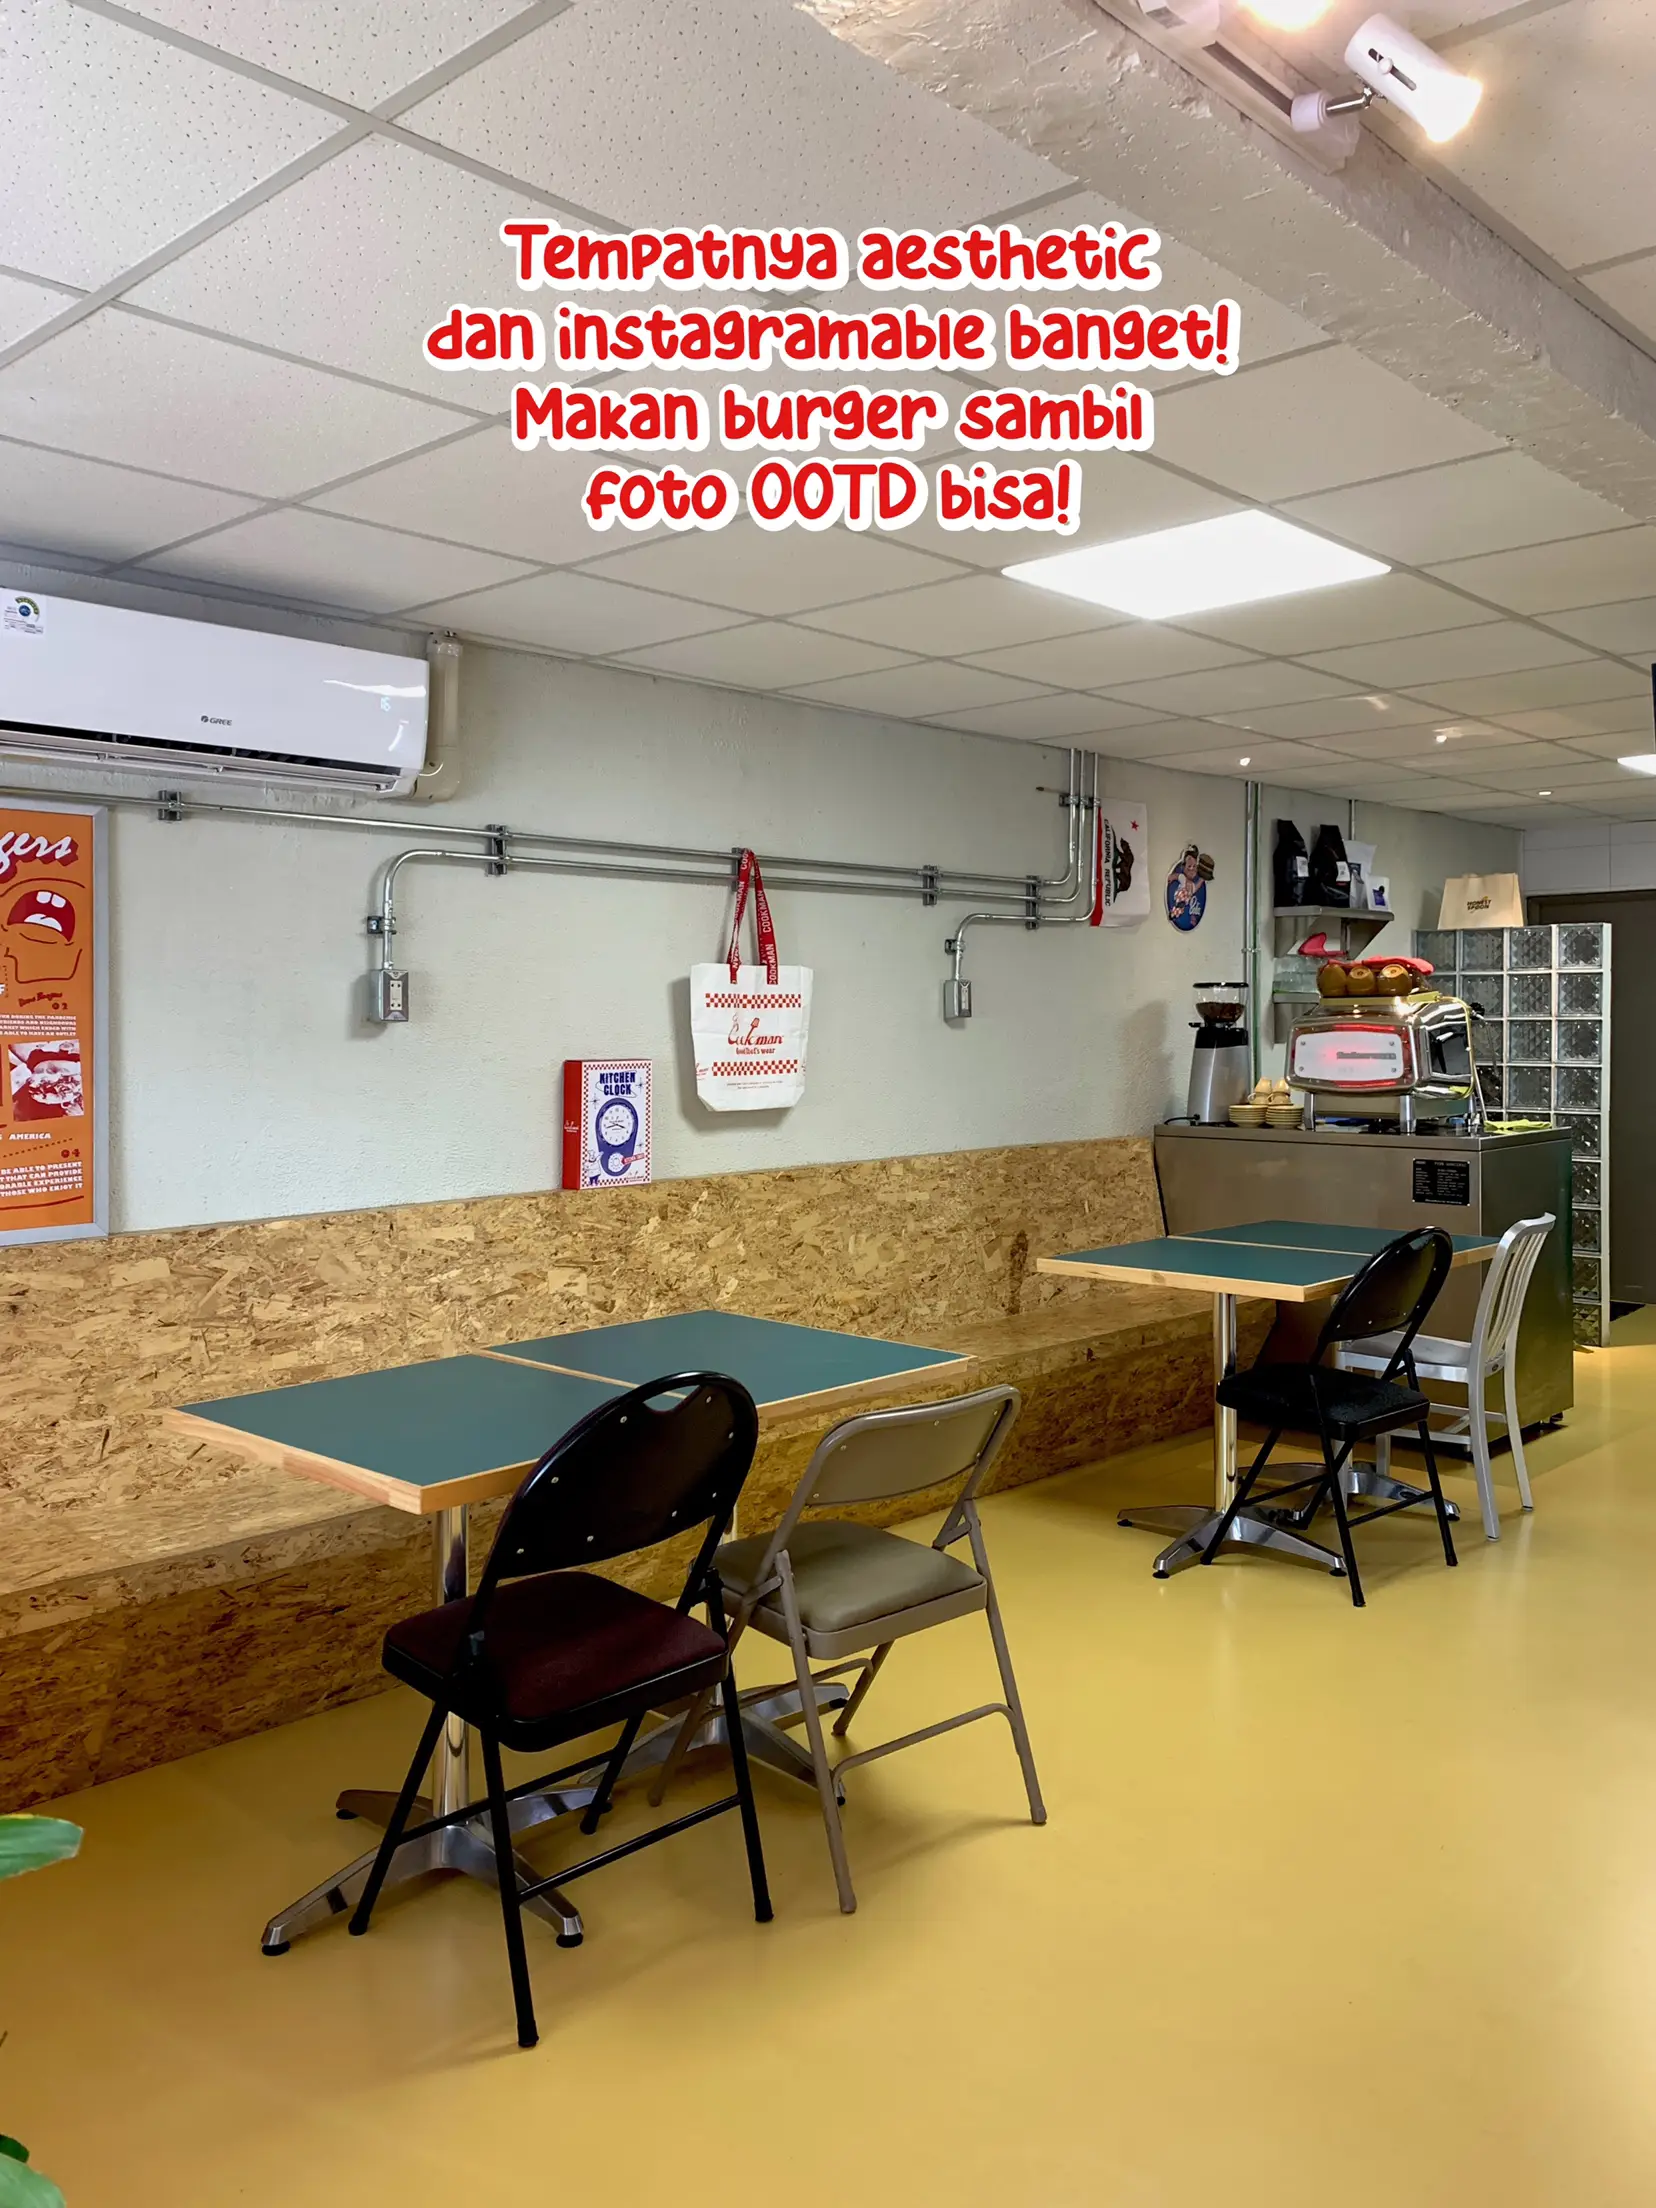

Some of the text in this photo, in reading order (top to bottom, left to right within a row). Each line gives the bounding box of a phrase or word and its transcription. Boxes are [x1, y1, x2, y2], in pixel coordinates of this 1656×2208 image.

[210, 717, 233, 726] GREE
[757, 890, 772, 933] COOKMAN
[600, 1072, 636, 1084] KITCHEN
[603, 1083, 632, 1096] CLOCK
[9, 1132, 51, 1141] AMERICA
[13, 1166, 34, 1175] ABLE
[48, 1161, 82, 1170] PRESENT
[5, 1174, 27, 1182] THAT
[48, 1169, 83, 1177] PROVIDE
[33, 1175, 83, 1187] EXPERIENCE
[49, 1184, 73, 1192] ENJOY
